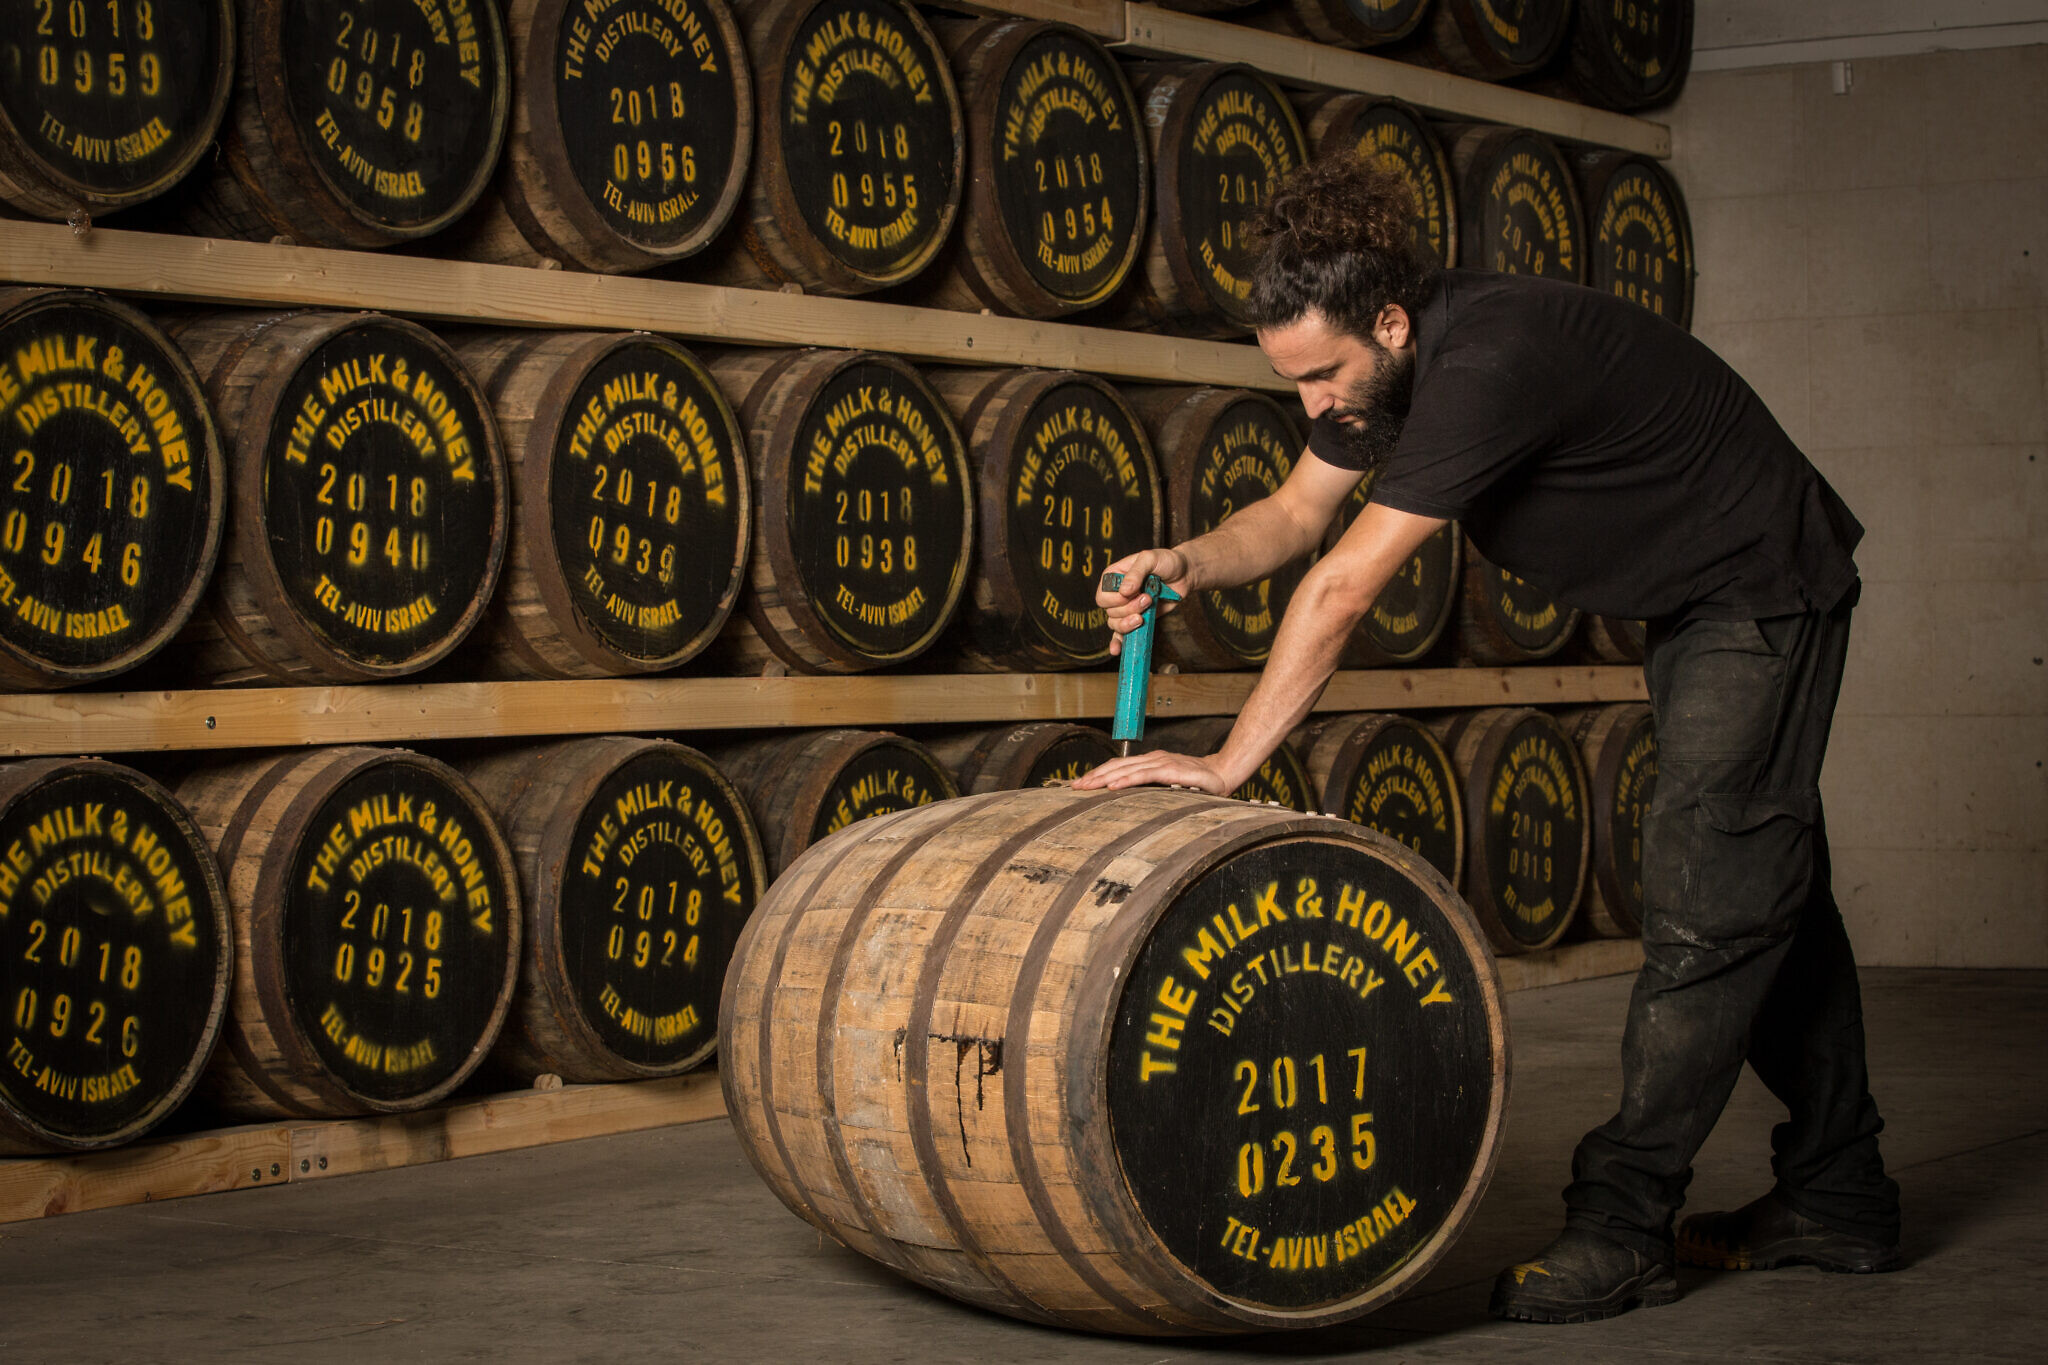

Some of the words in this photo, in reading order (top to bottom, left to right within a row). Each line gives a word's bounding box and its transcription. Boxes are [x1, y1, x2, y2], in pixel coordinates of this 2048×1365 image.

[35, 0, 154, 40] 2018
[564, 16, 592, 80] THE
[594, 11, 684, 63] DISTILLERY
[40, 46, 160, 95] 0959
[790, 60, 815, 124] THE
[806, 11, 855, 68] MILK
[857, 12, 870, 39] &
[873, 18, 933, 103] HONEY
[818, 49, 900, 104] DISTILLERY
[610, 82, 685, 127] 2018
[1004, 100, 1025, 161] THE
[1017, 52, 1056, 105] MILK
[1057, 50, 1071, 76] &
[1073, 56, 1122, 132] HONEY
[1027, 87, 1097, 146] DISTILLERY
[1193, 104, 1218, 155] THE
[1217, 90, 1254, 121] MILK
[1255, 101, 1267, 126] &
[40, 110, 111, 164] TEL-AVIV
[114, 117, 172, 163] ISRAEL
[315, 107, 374, 186] TEL-AVIV
[374, 169, 426, 199] ISRAEL
[613, 140, 697, 183] 0956
[658, 190, 700, 223] ISRAEL
[880, 208, 918, 247] ISRAEL
[1420, 163, 1440, 254] HONEY
[1491, 162, 1511, 200] THE
[1512, 152, 1541, 181] MILK
[1548, 187, 1573, 271] HONEY
[1600, 199, 1616, 244] THE
[1613, 177, 1642, 206] MILK
[1652, 190, 1679, 264] HONEY
[1081, 232, 1114, 272] ISRAEL
[16, 383, 151, 455] DISTILLERY
[17, 335, 98, 384] MILK
[103, 345, 125, 380] &
[127, 364, 193, 492] HONEY
[285, 394, 326, 465] THE
[321, 354, 388, 405] MILK
[391, 358, 410, 392] &
[412, 371, 476, 482] HONEY
[326, 399, 437, 457] DISTILLERY
[569, 395, 607, 460] THE
[604, 372, 659, 411] MILK
[663, 381, 677, 411] &
[680, 397, 726, 505] HONEY
[604, 412, 696, 475] DISTILLERY
[804, 428, 832, 495] THE
[825, 385, 875, 438] MILK
[878, 387, 892, 416] &
[896, 395, 949, 487] HONEY
[833, 424, 919, 478] DISTILLERY
[1016, 446, 1042, 507] THE
[1035, 405, 1078, 454] MILK
[1080, 407, 1093, 433] &
[1097, 414, 1141, 500] HONEY
[1044, 442, 1115, 488] DISTILLERY
[1201, 444, 1225, 497] THE
[1222, 421, 1259, 454] MILK
[13, 449, 149, 519] 2018
[317, 463, 427, 518] 2018
[836, 486, 913, 525] 2018
[4, 510, 141, 587] 0946
[65, 604, 131, 639] ISRAEL
[384, 595, 437, 634] ISRAEL
[639, 598, 683, 630] ISRAEL
[888, 585, 926, 626] ISRAEL
[850, 767, 899, 811] MILK
[902, 775, 915, 803] &
[1350, 774, 1372, 823] THE
[1368, 744, 1401, 782] MILK
[1403, 746, 1414, 770] &
[1414, 754, 1446, 832] HONEY
[1370, 776, 1428, 815] DISTILLERY
[308, 822, 353, 893] THE
[349, 793, 414, 838] MILK
[419, 800, 437, 836] &
[439, 817, 493, 936] HONEY
[350, 837, 457, 901] DISTILLERY
[582, 813, 619, 878] THE
[616, 780, 674, 824] MILK
[676, 786, 692, 816] &
[694, 800, 742, 905] HONEY
[619, 822, 711, 877] DISTILLERY
[29, 803, 103, 857] MILK
[110, 809, 128, 846] &
[131, 824, 197, 949] HONEY
[32, 852, 153, 917] DISTILLERY
[613, 876, 702, 927] 2018
[341, 890, 444, 953] 2018
[24, 920, 142, 990] 2018
[1140, 976, 1197, 1082] THE
[1182, 881, 1287, 979] MILK
[1295, 879, 1325, 919] &
[1334, 884, 1454, 1007] HONEY
[1208, 942, 1386, 1036] DISTILLERY
[15, 987, 140, 1058] 0926
[654, 1003, 699, 1044] ISRAEL
[8, 1037, 77, 1100] TEL-AVIV
[81, 1063, 141, 1102] ISRAEL
[384, 1037, 439, 1073] ISRAEL
[1234, 1047, 1366, 1115] 2017
[1237, 1113, 1376, 1198] 0235
[1220, 1216, 1329, 1270] TEL-AVIV
[1335, 1186, 1417, 1262] ISRAEL
